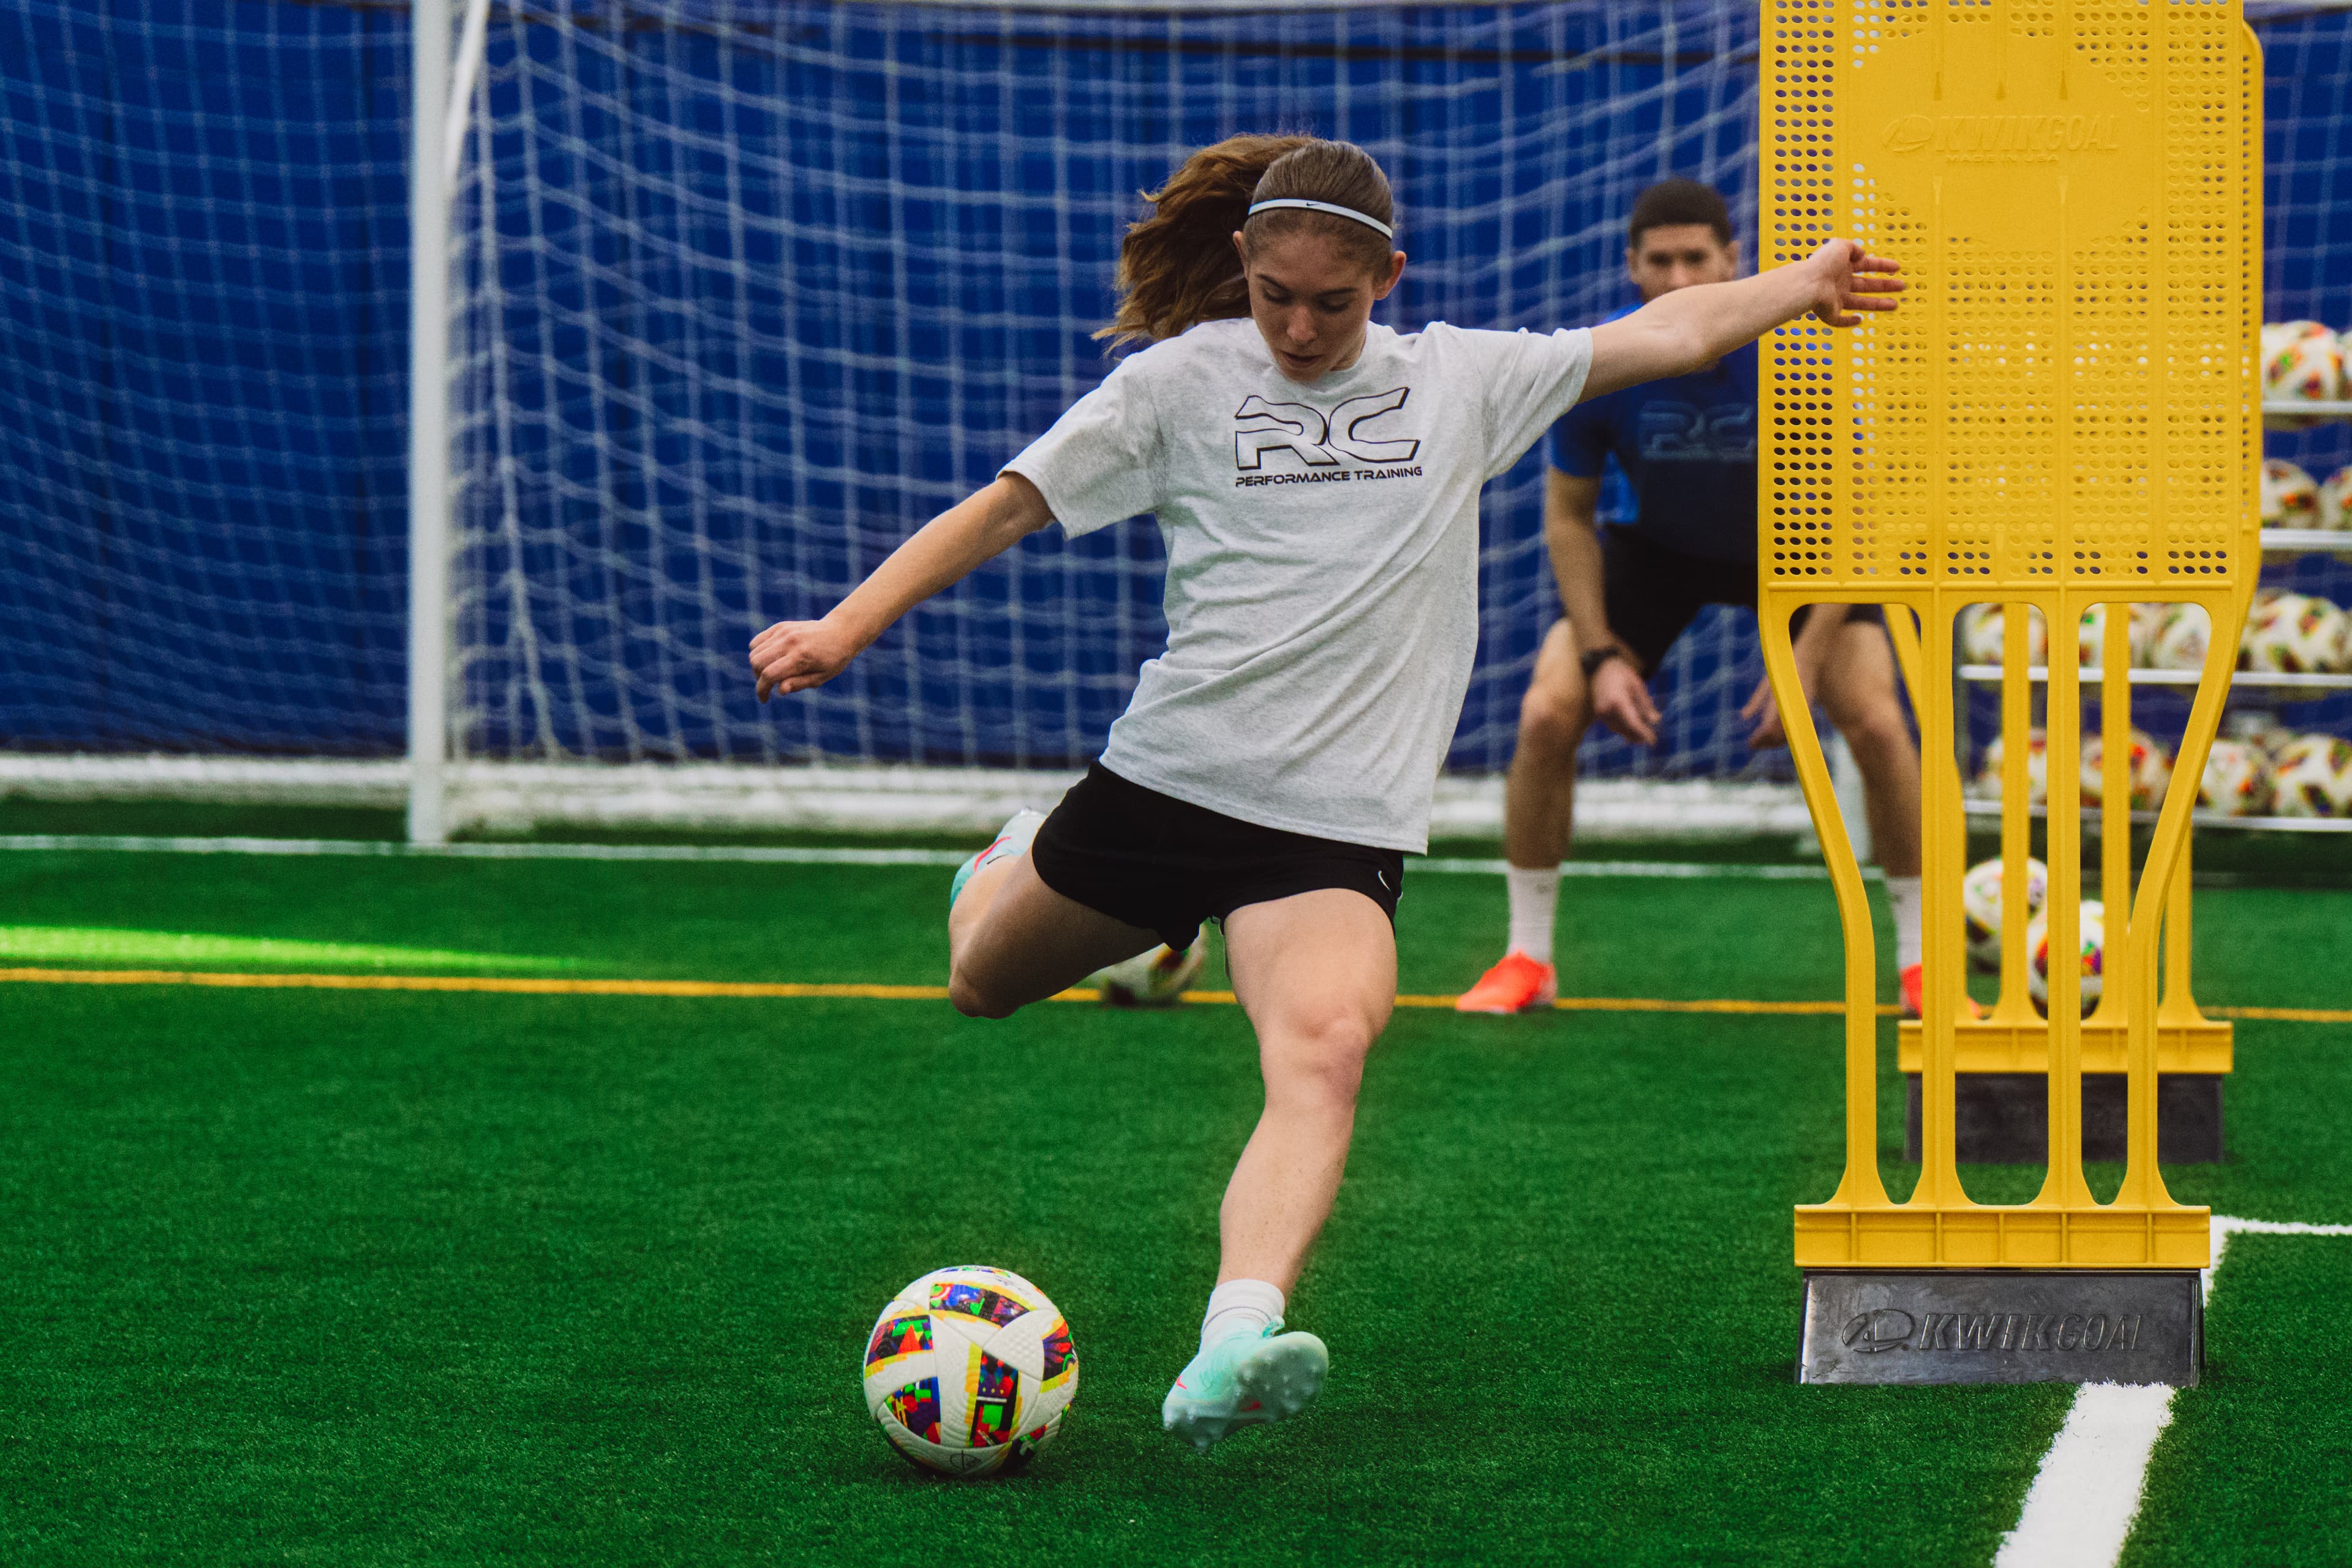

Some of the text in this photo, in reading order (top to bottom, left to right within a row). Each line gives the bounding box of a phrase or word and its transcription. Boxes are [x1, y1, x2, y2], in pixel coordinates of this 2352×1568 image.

[1945, 154, 2060, 164] MADE IN USA
[1235, 386, 1421, 470] RC
[1235, 466, 1423, 488] PERFORMANCE TRAINING
